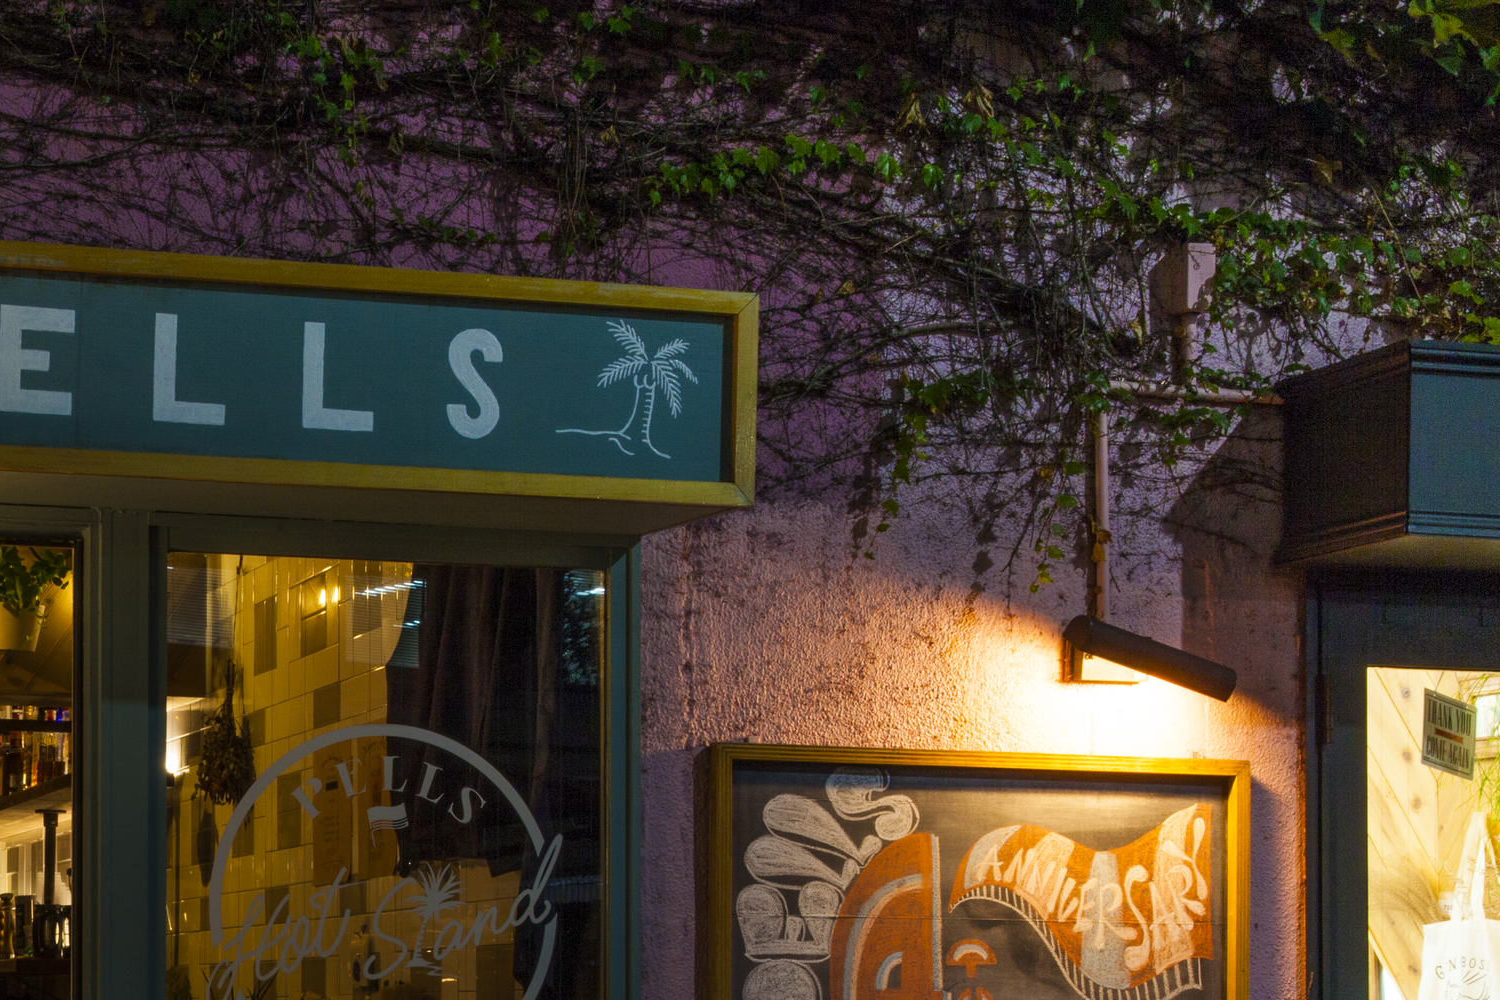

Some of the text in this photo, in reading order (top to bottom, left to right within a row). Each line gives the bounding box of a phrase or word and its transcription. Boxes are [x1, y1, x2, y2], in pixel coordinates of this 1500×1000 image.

[1427, 698, 1472, 736] THANK YOU
[1426, 734, 1470, 769] COME AGAIN
[291, 755, 486, 823] PELLS
[975, 817, 1208, 972] ANNIVERSARY
